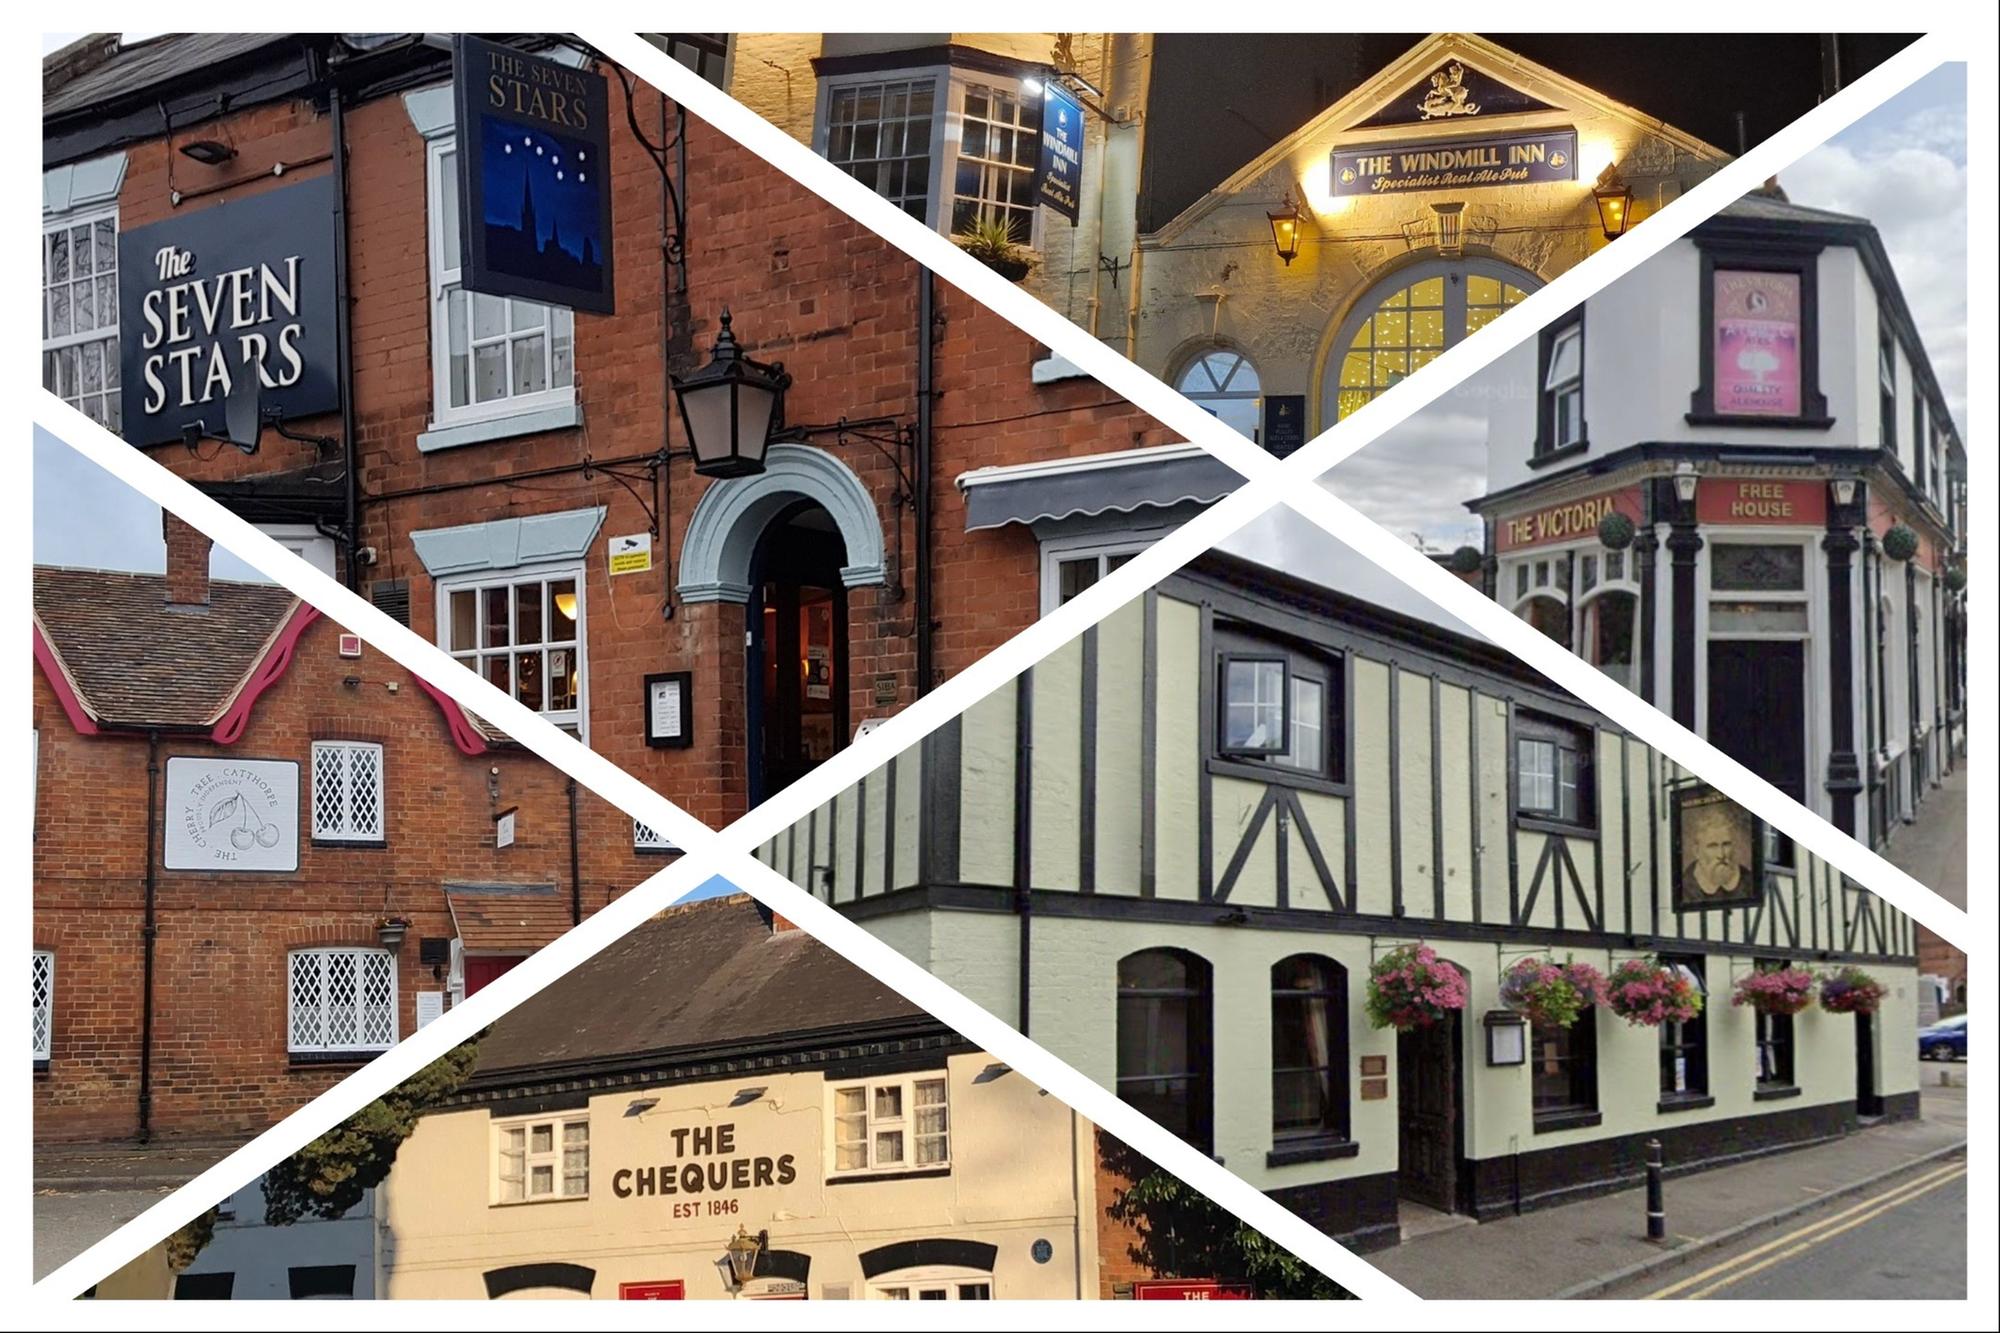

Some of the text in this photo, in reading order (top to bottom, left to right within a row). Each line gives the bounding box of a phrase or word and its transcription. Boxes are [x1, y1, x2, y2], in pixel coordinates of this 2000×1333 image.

[488, 51, 587, 95] THE SEVEN
[489, 74, 588, 130] STARS
[1043, 130, 1078, 165] WINDMILL
[1056, 127, 1068, 142] THE
[1052, 154, 1068, 174] INN
[1356, 143, 1545, 176] THE WINDMILL INN
[1371, 167, 1529, 192] Specialist Real Ale Pub
[154, 245, 192, 281] The
[142, 255, 300, 349] SEVEN
[143, 323, 303, 414] STARS
[1740, 484, 1783, 498] FREE
[1507, 497, 1615, 545] THE VICTORIA
[1731, 502, 1792, 517] HOUSE
[185, 768, 278, 861] THE CHERRY TREE CATTHORPE
[670, 1123, 736, 1158] THE
[612, 1154, 797, 1199] CHEQUERS
[673, 1199, 739, 1219] EST 1846
[1183, 1291, 1210, 1300] THE
